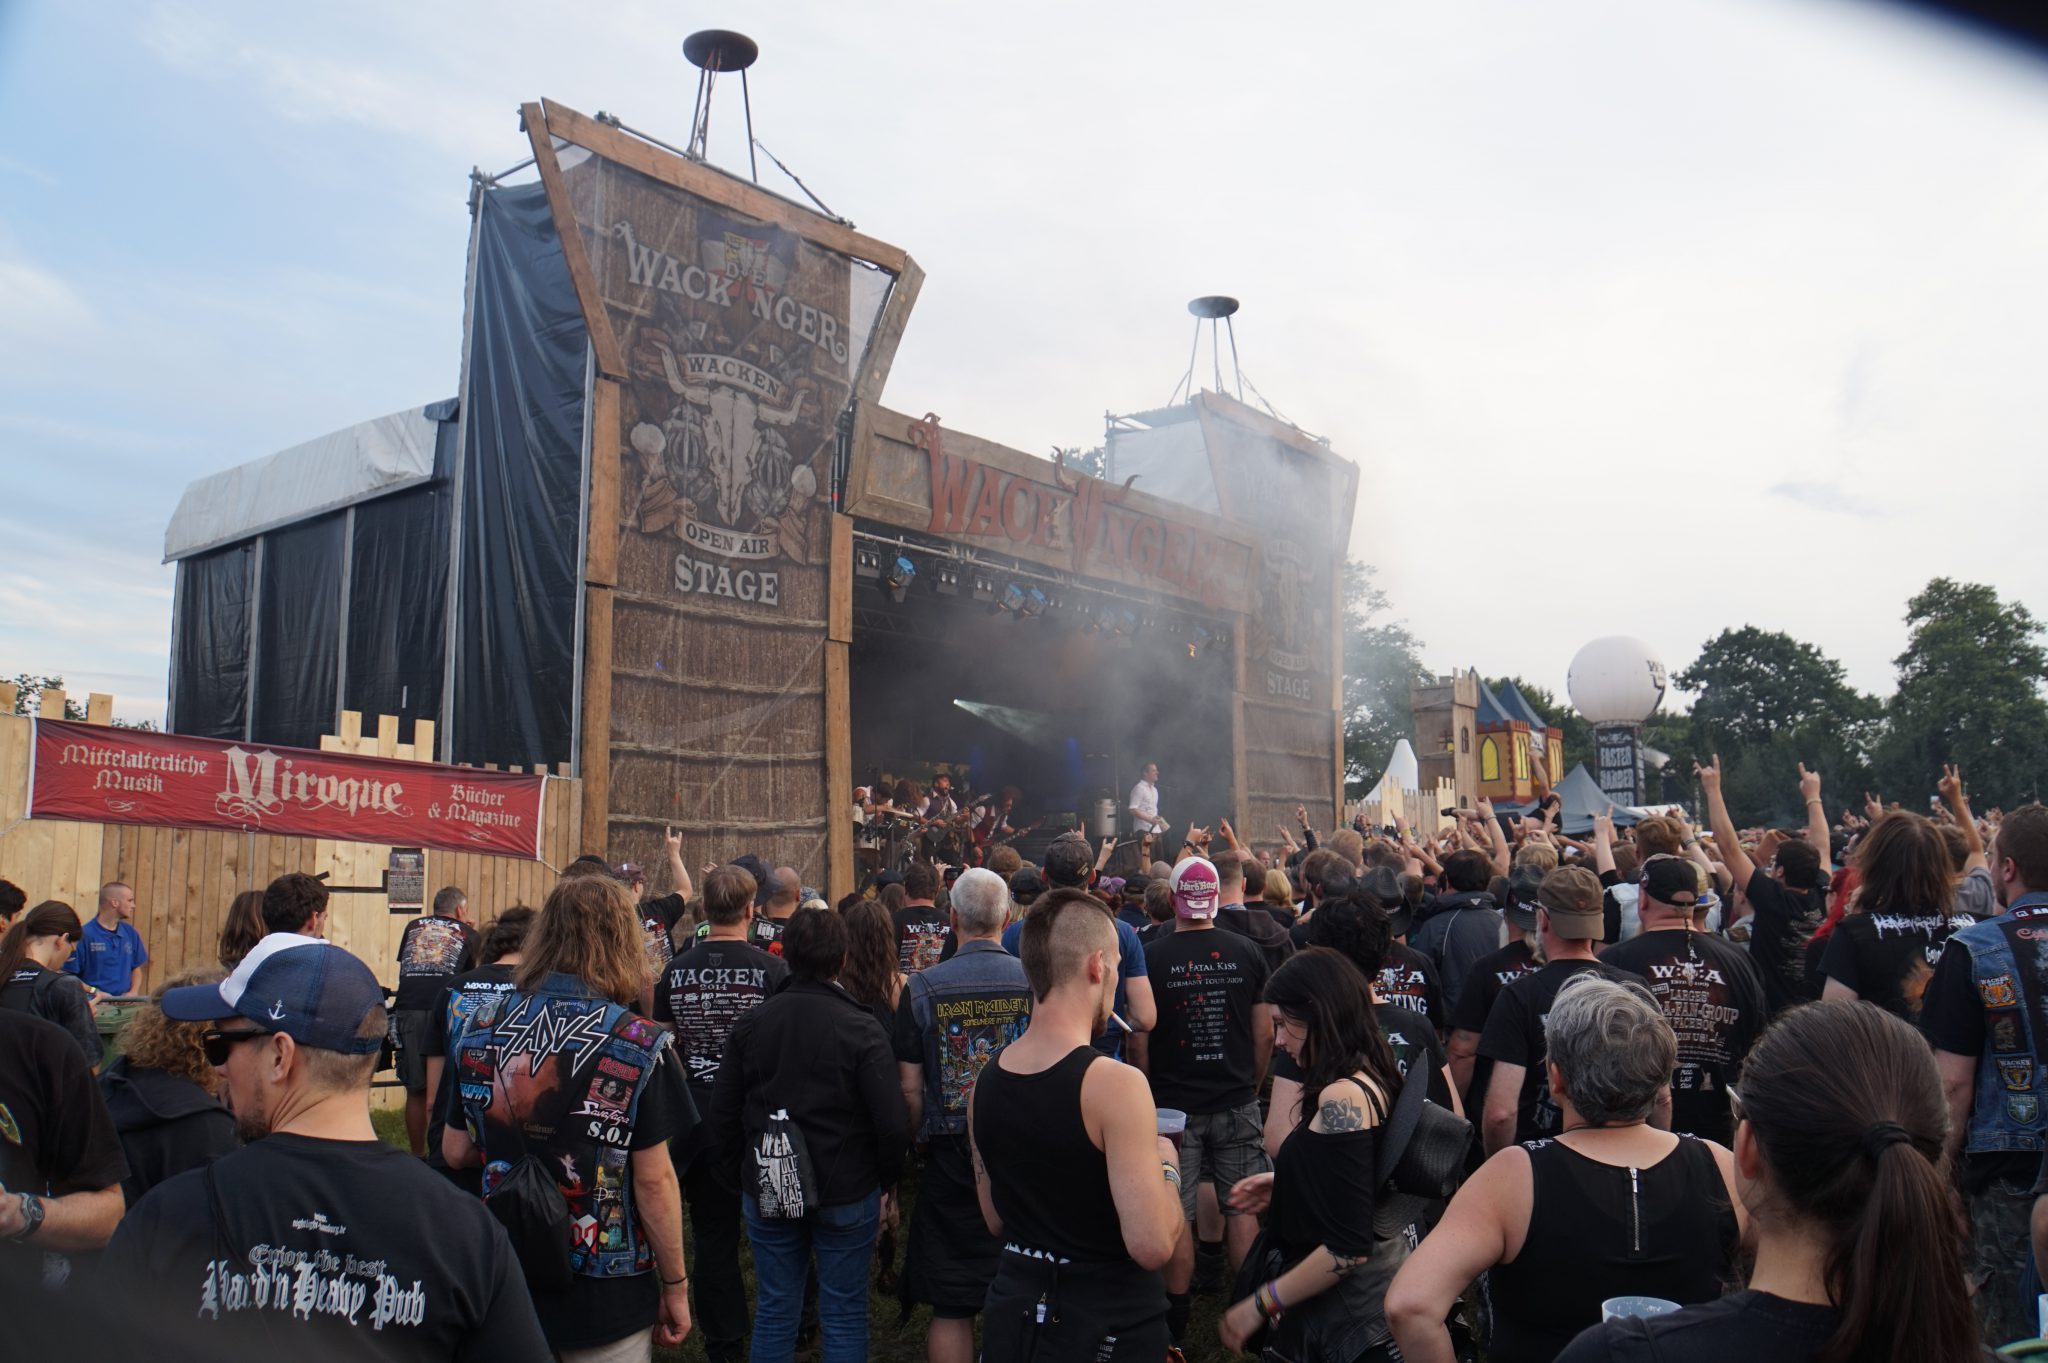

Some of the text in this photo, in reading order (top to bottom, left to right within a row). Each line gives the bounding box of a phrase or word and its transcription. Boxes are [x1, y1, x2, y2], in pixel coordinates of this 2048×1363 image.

[688, 356, 780, 398] WACKEN
[686, 523, 769, 554] OPEN AIR
[674, 554, 778, 607] STAGE
[1267, 670, 1311, 700] STAGE
[1600, 746, 1632, 767] FASTER
[59, 743, 505, 820] Mittelalterliche Miroque Bücher
[92, 769, 163, 793] Musik
[427, 802, 521, 829] & Magazine
[670, 968, 766, 989] WACKEN
[1170, 962, 1237, 974] MY FATAL KISS
[700, 983, 728, 991] 2014
[1166, 979, 1203, 988] GERMANY
[937, 998, 1029, 1018] IRON MAIDEN
[963, 1017, 995, 1027] SOMEWHERE
[495, 996, 609, 1078] SADUS
[782, 1183, 803, 1205] BAG
[314, 1248, 340, 1273] the
[345, 1253, 388, 1278] best
[292, 1261, 367, 1326] Heavy
[368, 1273, 426, 1331] Pub
